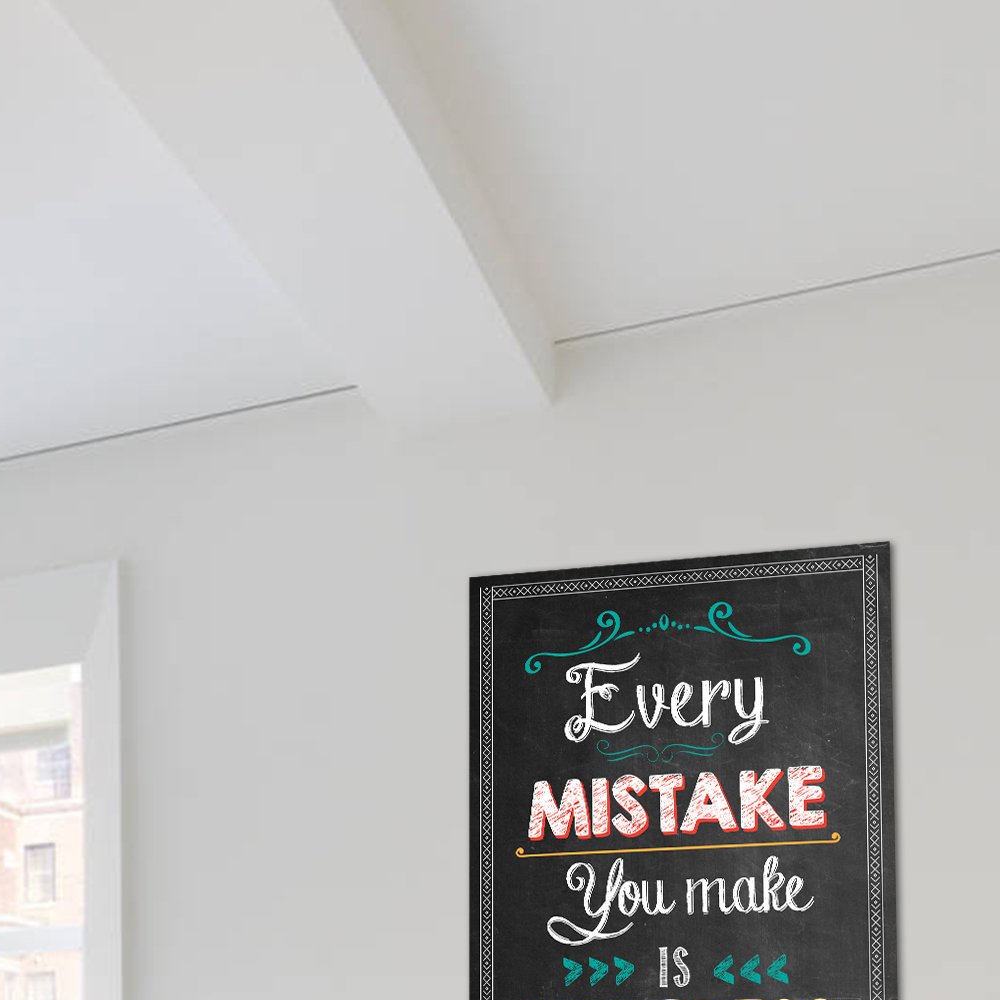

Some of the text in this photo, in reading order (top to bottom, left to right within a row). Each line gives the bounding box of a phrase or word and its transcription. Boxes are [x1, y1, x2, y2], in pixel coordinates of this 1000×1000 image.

[564, 653, 769, 744] Every
[528, 766, 828, 840] MISTAKE
[547, 856, 814, 945] You make
[659, 947, 690, 987] IS
